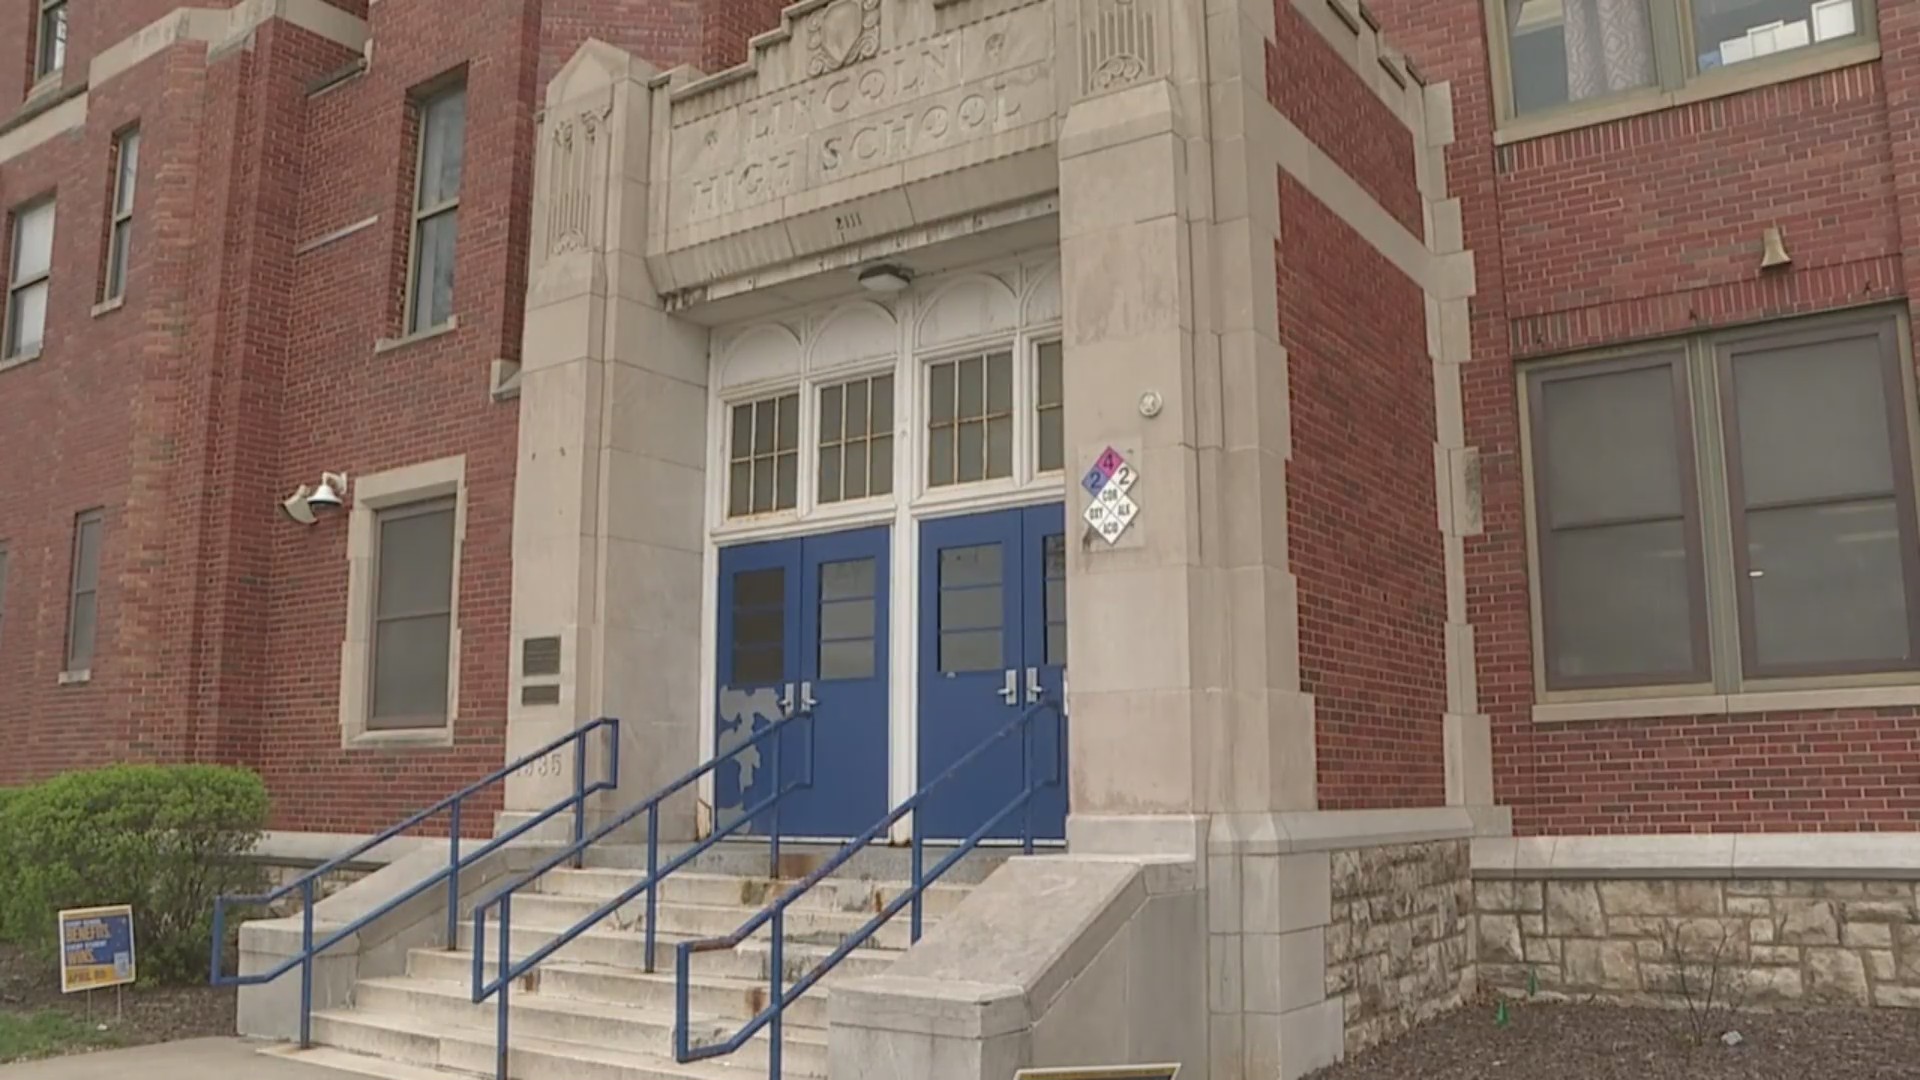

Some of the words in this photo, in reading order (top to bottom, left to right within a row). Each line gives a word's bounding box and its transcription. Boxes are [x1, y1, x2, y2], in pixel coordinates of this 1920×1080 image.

[747, 44, 953, 142] LINCOLN
[691, 150, 796, 215] HIGH
[821, 83, 1022, 172] SCHOOL
[836, 212, 863, 232] 2111
[1103, 454, 1114, 471] 4
[1090, 471, 1100, 489] 2
[1119, 468, 1129, 485] 2
